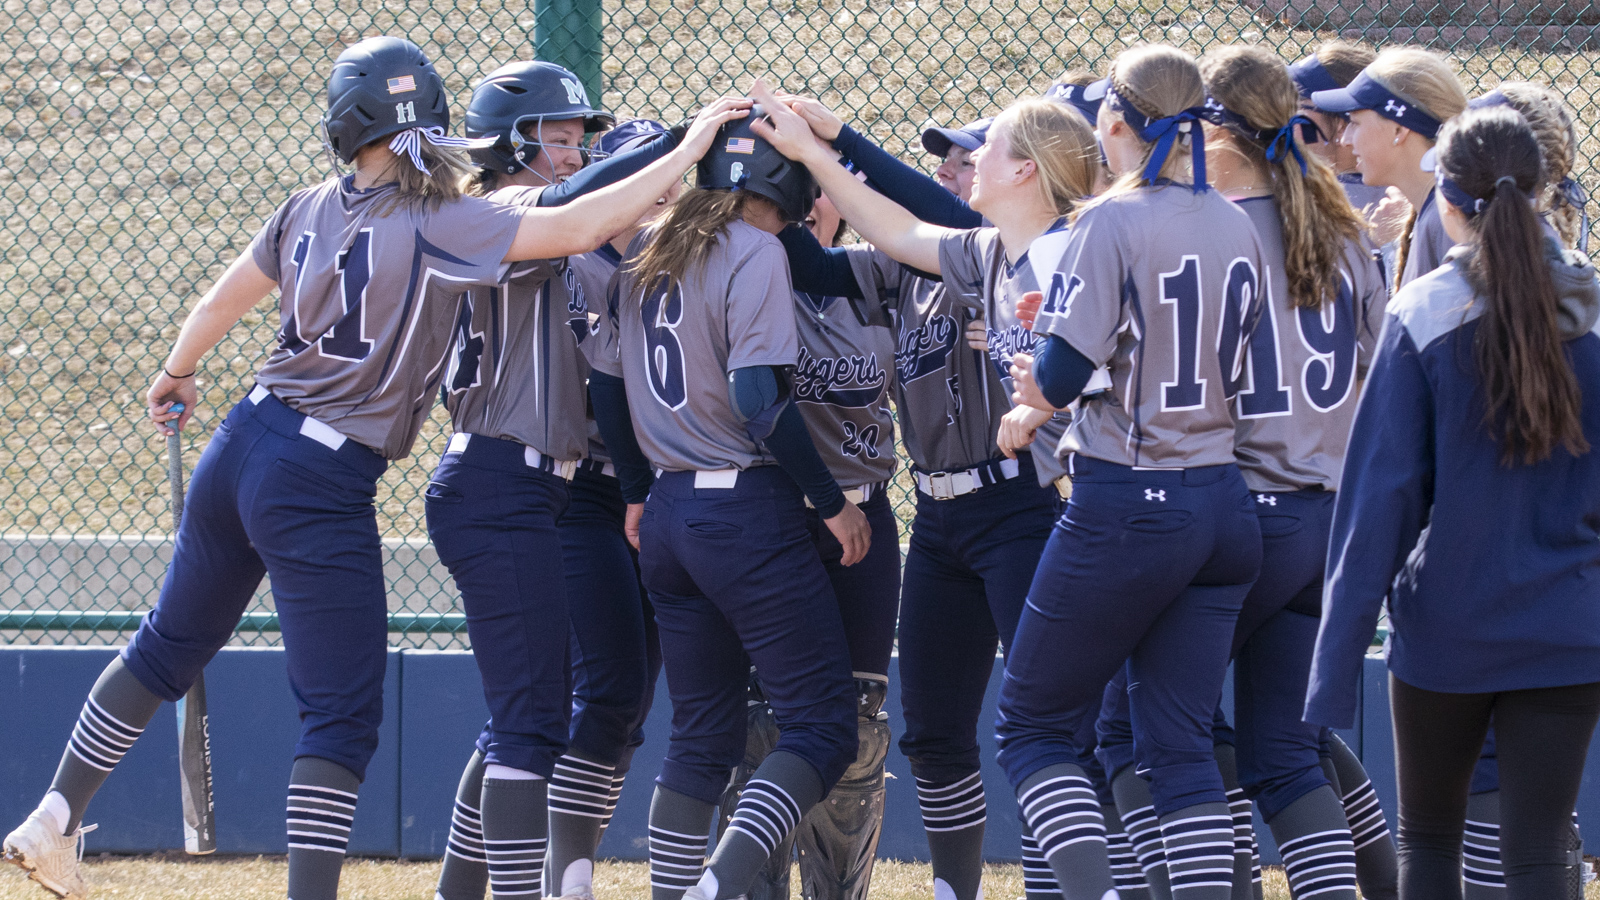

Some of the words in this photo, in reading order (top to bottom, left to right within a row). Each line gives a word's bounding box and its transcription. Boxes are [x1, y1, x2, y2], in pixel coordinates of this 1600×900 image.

[561, 77, 591, 107] M
[1053, 84, 1075, 100] M
[395, 101, 417, 124] 11
[632, 119, 656, 135] M
[730, 161, 744, 183] 6
[276, 226, 376, 364] 11
[640, 269, 688, 413] 6
[1236, 262, 1358, 420] 19
[841, 420, 881, 459] 20
[202, 715, 214, 812] LOUISVILLE
